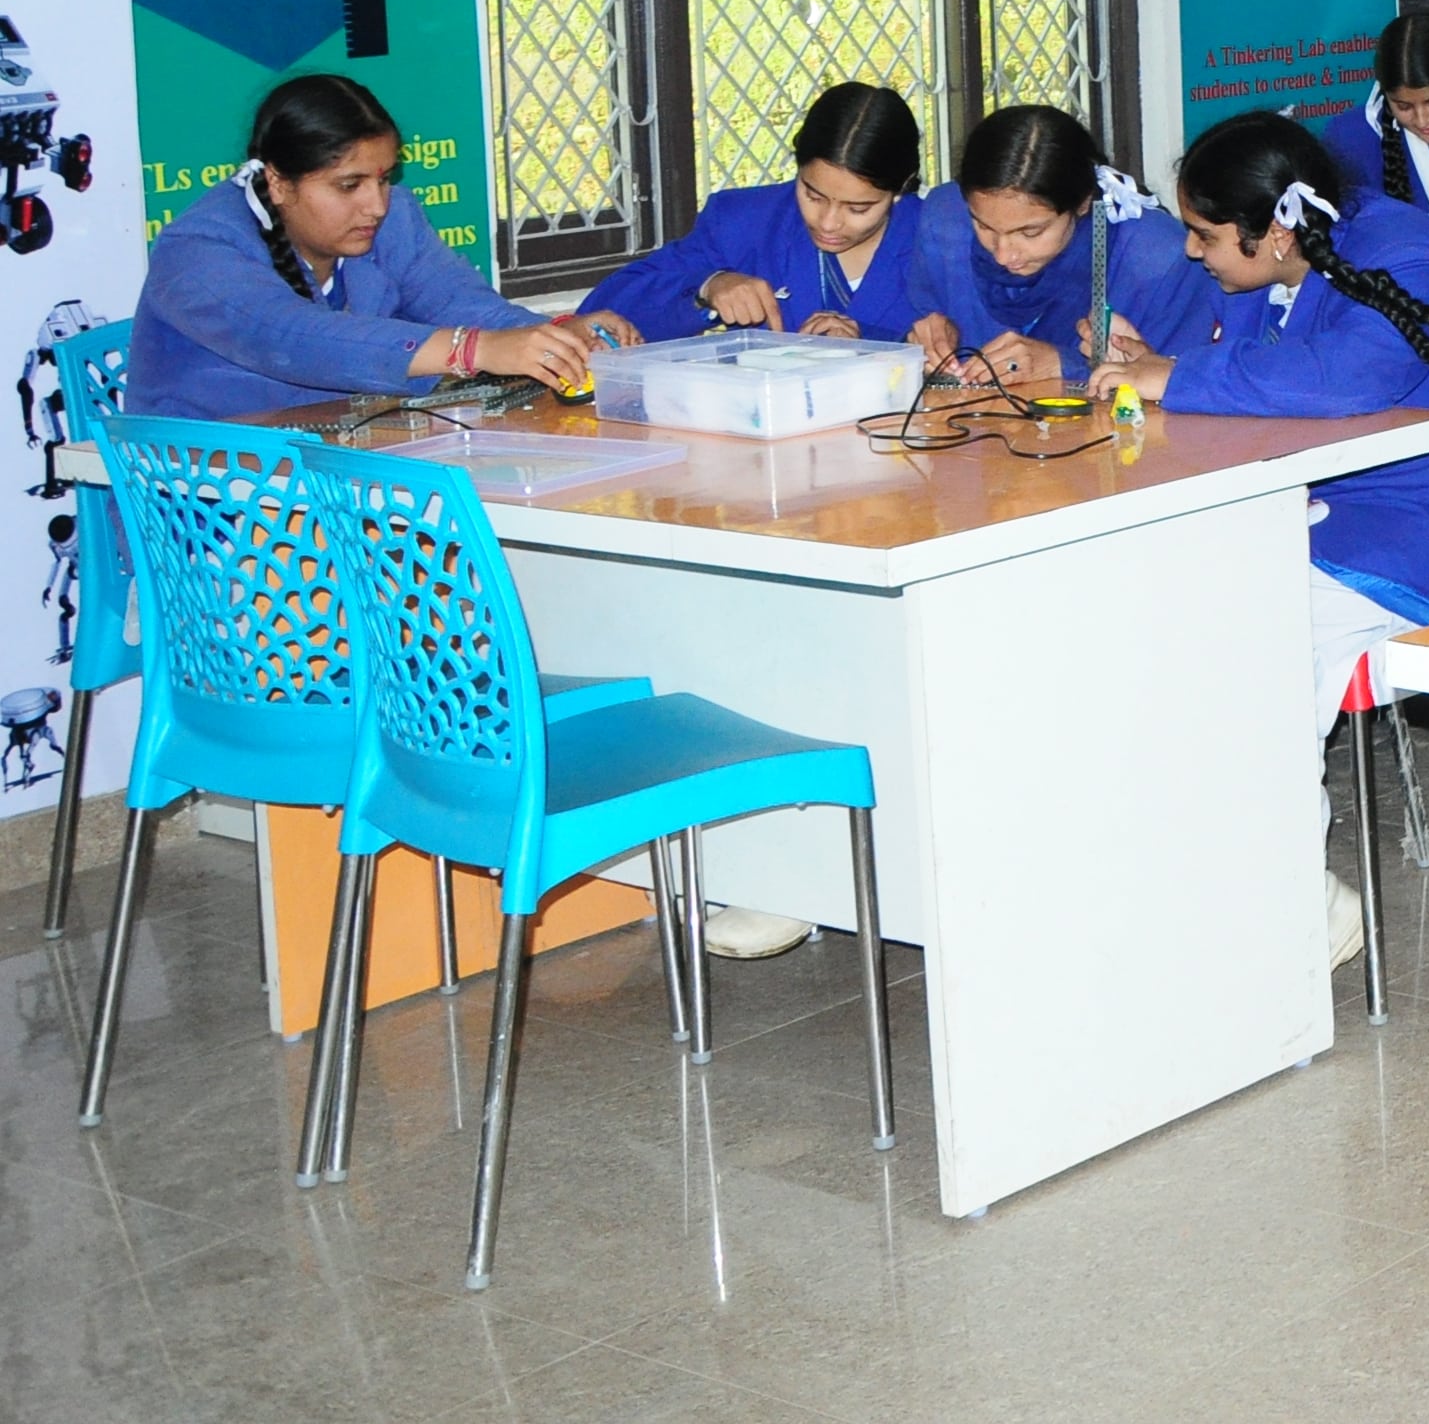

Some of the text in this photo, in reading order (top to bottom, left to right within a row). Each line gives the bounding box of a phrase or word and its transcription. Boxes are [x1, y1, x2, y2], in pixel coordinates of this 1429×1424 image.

[1205, 33, 1380, 68] A Tinkering Lab enable
[1190, 79, 1249, 102] students
[1255, 78, 1269, 94] to
[1273, 71, 1317, 92] create
[1321, 67, 1333, 86] &
